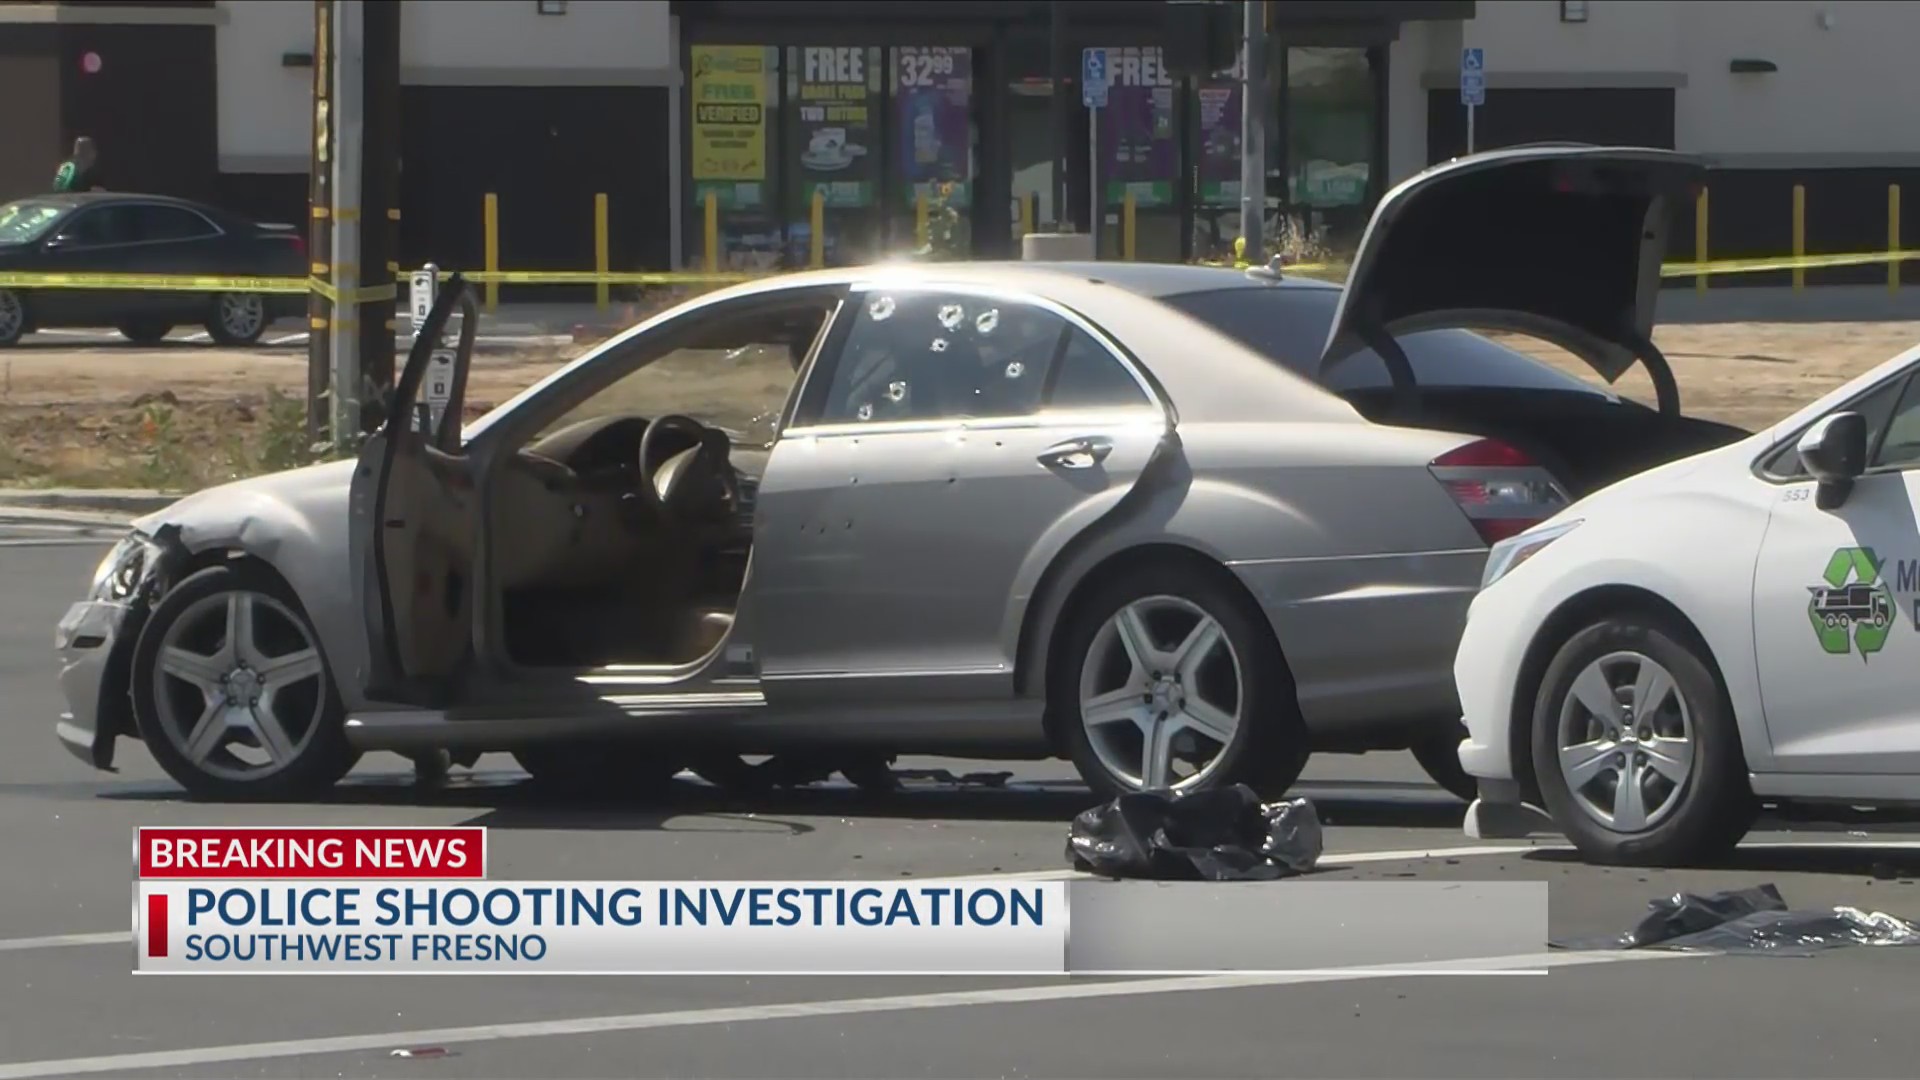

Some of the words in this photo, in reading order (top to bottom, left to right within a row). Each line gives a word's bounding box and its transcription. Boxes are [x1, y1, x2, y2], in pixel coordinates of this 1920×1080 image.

[805, 47, 864, 82] FREE
[702, 84, 754, 99] FREE
[700, 105, 759, 122] VERIFIED
